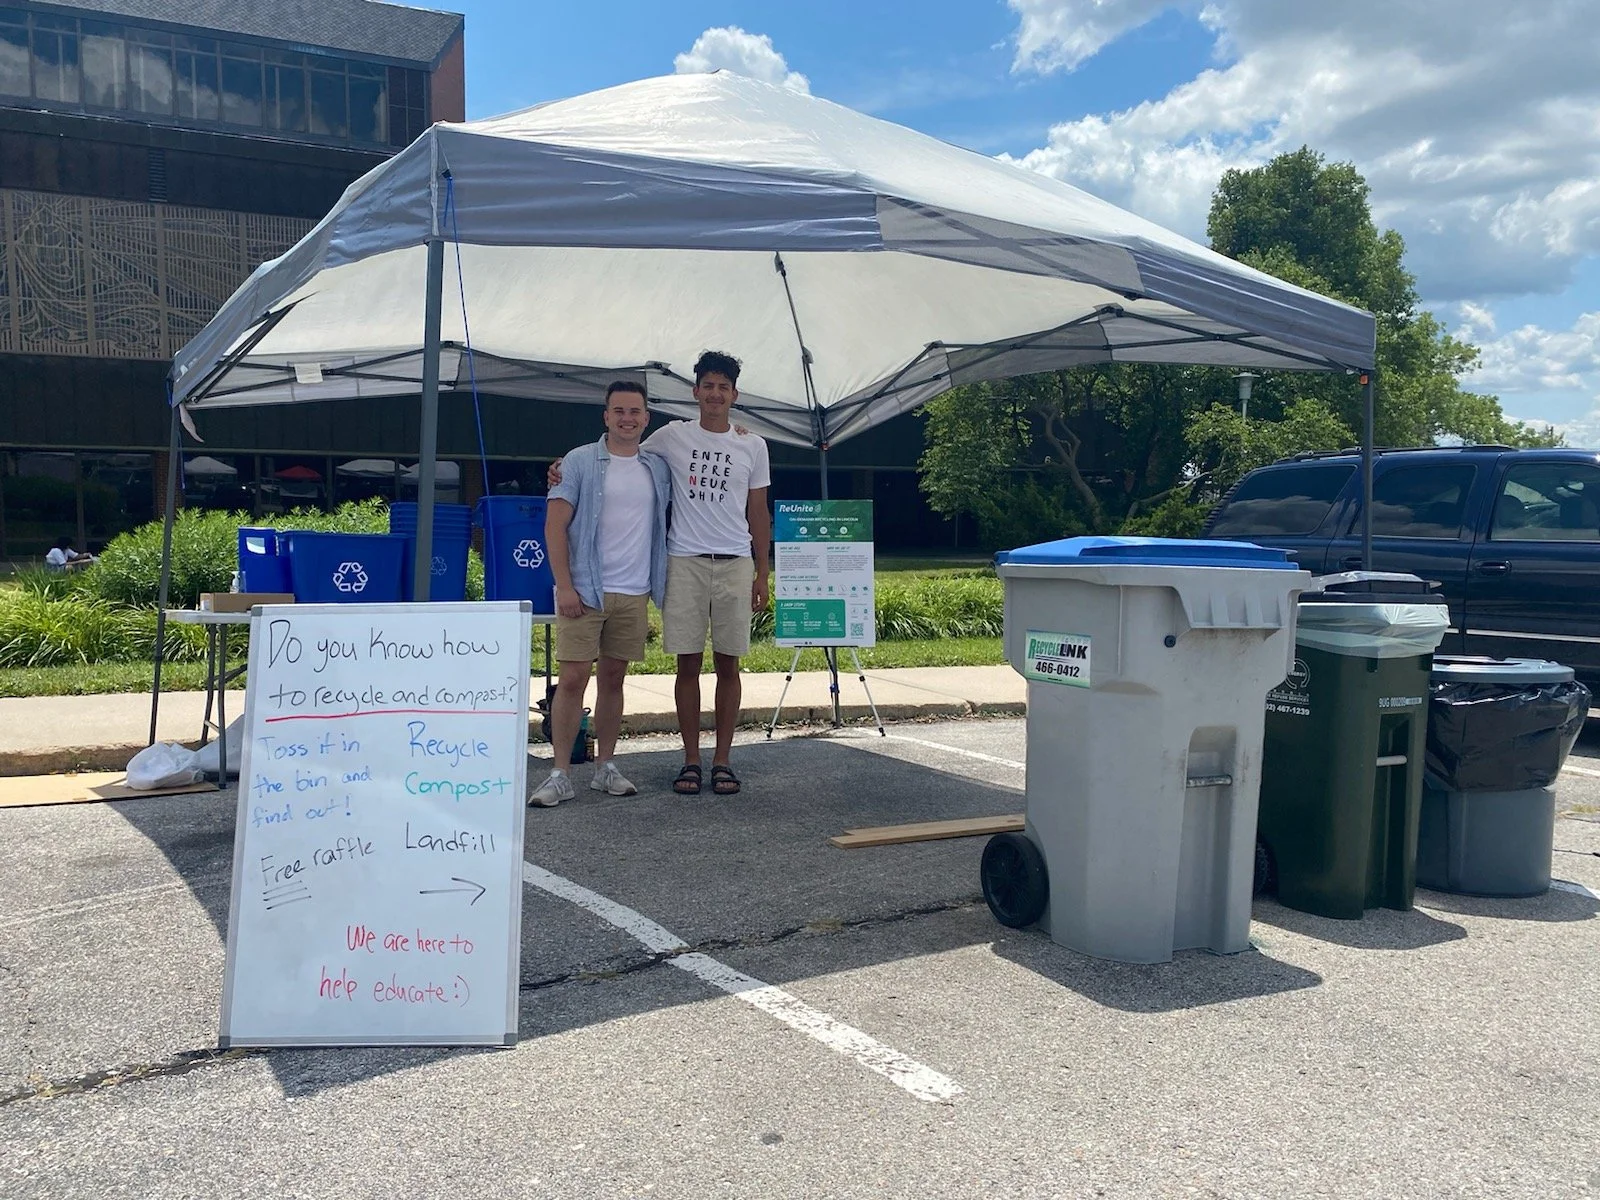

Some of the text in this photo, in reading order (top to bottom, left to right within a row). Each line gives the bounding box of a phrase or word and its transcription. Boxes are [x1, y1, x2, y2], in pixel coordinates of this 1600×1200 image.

[689, 462, 731, 477] EPRE
[692, 449, 733, 466] ENTR
[689, 475, 728, 492] NEUR
[689, 489, 725, 503] SHIP
[779, 504, 814, 513] ReUnite
[268, 619, 302, 669] Do
[313, 637, 357, 673] you
[443, 628, 500, 657] how
[1035, 661, 1080, 678] 466-0412
[268, 676, 518, 715] to recycle and compost?
[1277, 704, 1310, 716] 467-1239
[258, 732, 361, 761] Toss it in
[407, 720, 492, 768] Recycle
[252, 765, 374, 799] the bin and
[405, 771, 512, 802] Compost
[251, 803, 293, 827] find
[405, 822, 496, 853] Landfill
[260, 836, 377, 886] Free raffle
[347, 924, 474, 955] We are here to
[320, 965, 358, 1002] help
